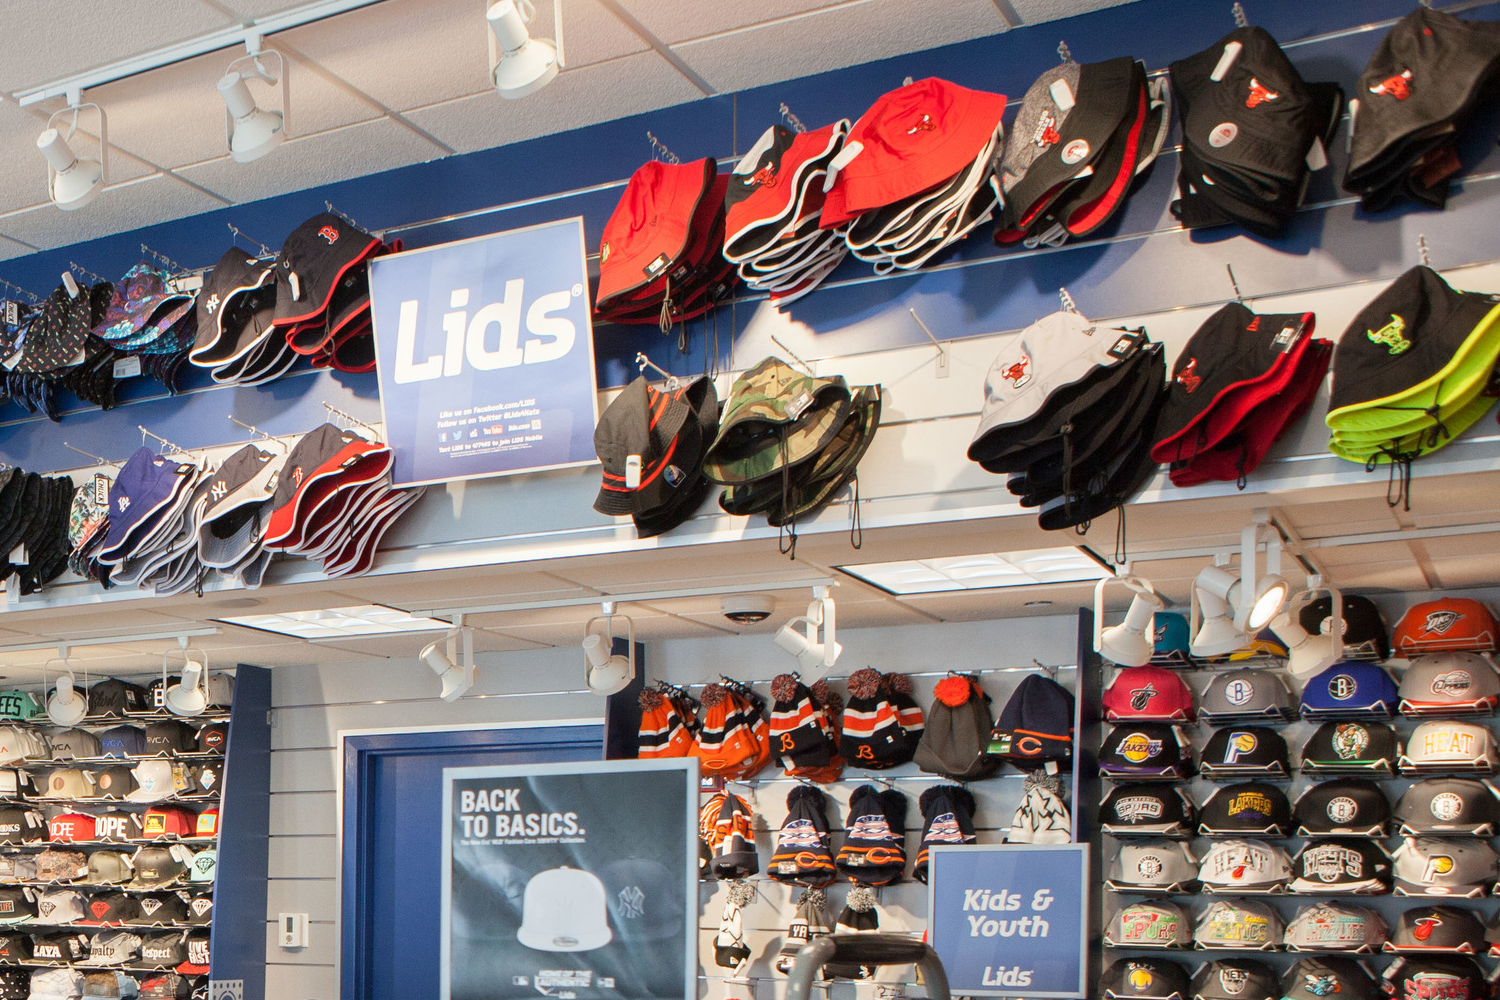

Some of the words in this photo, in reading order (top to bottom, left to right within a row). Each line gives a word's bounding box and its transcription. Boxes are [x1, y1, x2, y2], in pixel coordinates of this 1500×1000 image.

[318, 225, 339, 245] B
[394, 278, 577, 384] Lids
[1120, 740, 1160, 753] LAKERS
[1423, 732, 1474, 755] HEAT
[461, 789, 520, 813] BACK
[1118, 803, 1158, 814] SPURS
[95, 817, 128, 837] DOPE
[460, 815, 488, 838] TO
[496, 812, 586, 837] BASICS.
[1214, 847, 1268, 876] HEAT
[963, 889, 1021, 911] Kids
[1031, 888, 1054, 911] &
[968, 915, 1049, 938] Youth
[1125, 921, 1178, 940] SPURS
[189, 941, 208, 950] LIVE
[982, 966, 1032, 987] Lids
